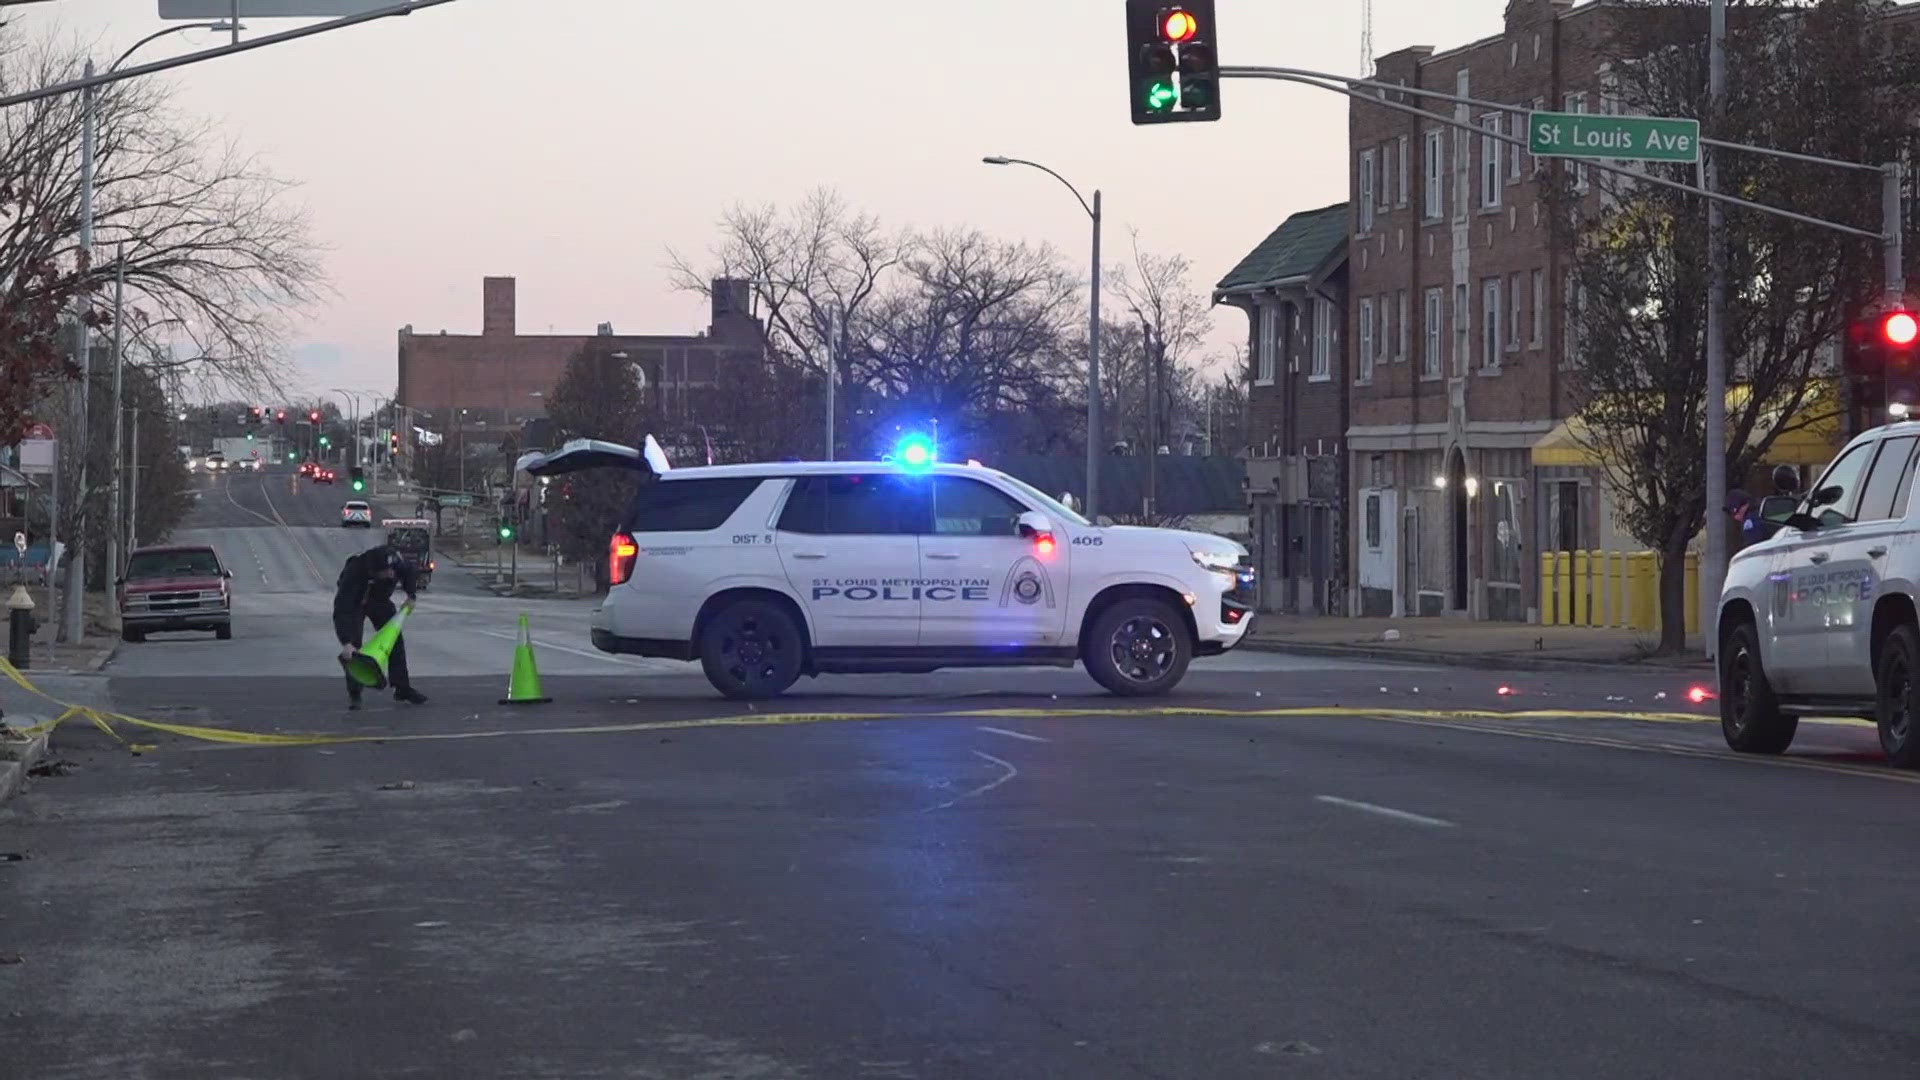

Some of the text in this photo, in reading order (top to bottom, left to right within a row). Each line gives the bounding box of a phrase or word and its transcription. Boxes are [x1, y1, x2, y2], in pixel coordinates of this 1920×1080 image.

[1538, 123, 1690, 151] St Louis Ave
[812, 578, 990, 586] ST. LOUIS METROPOLITAN
[812, 587, 990, 600] POLICE
[1797, 581, 1872, 606] POLICE
